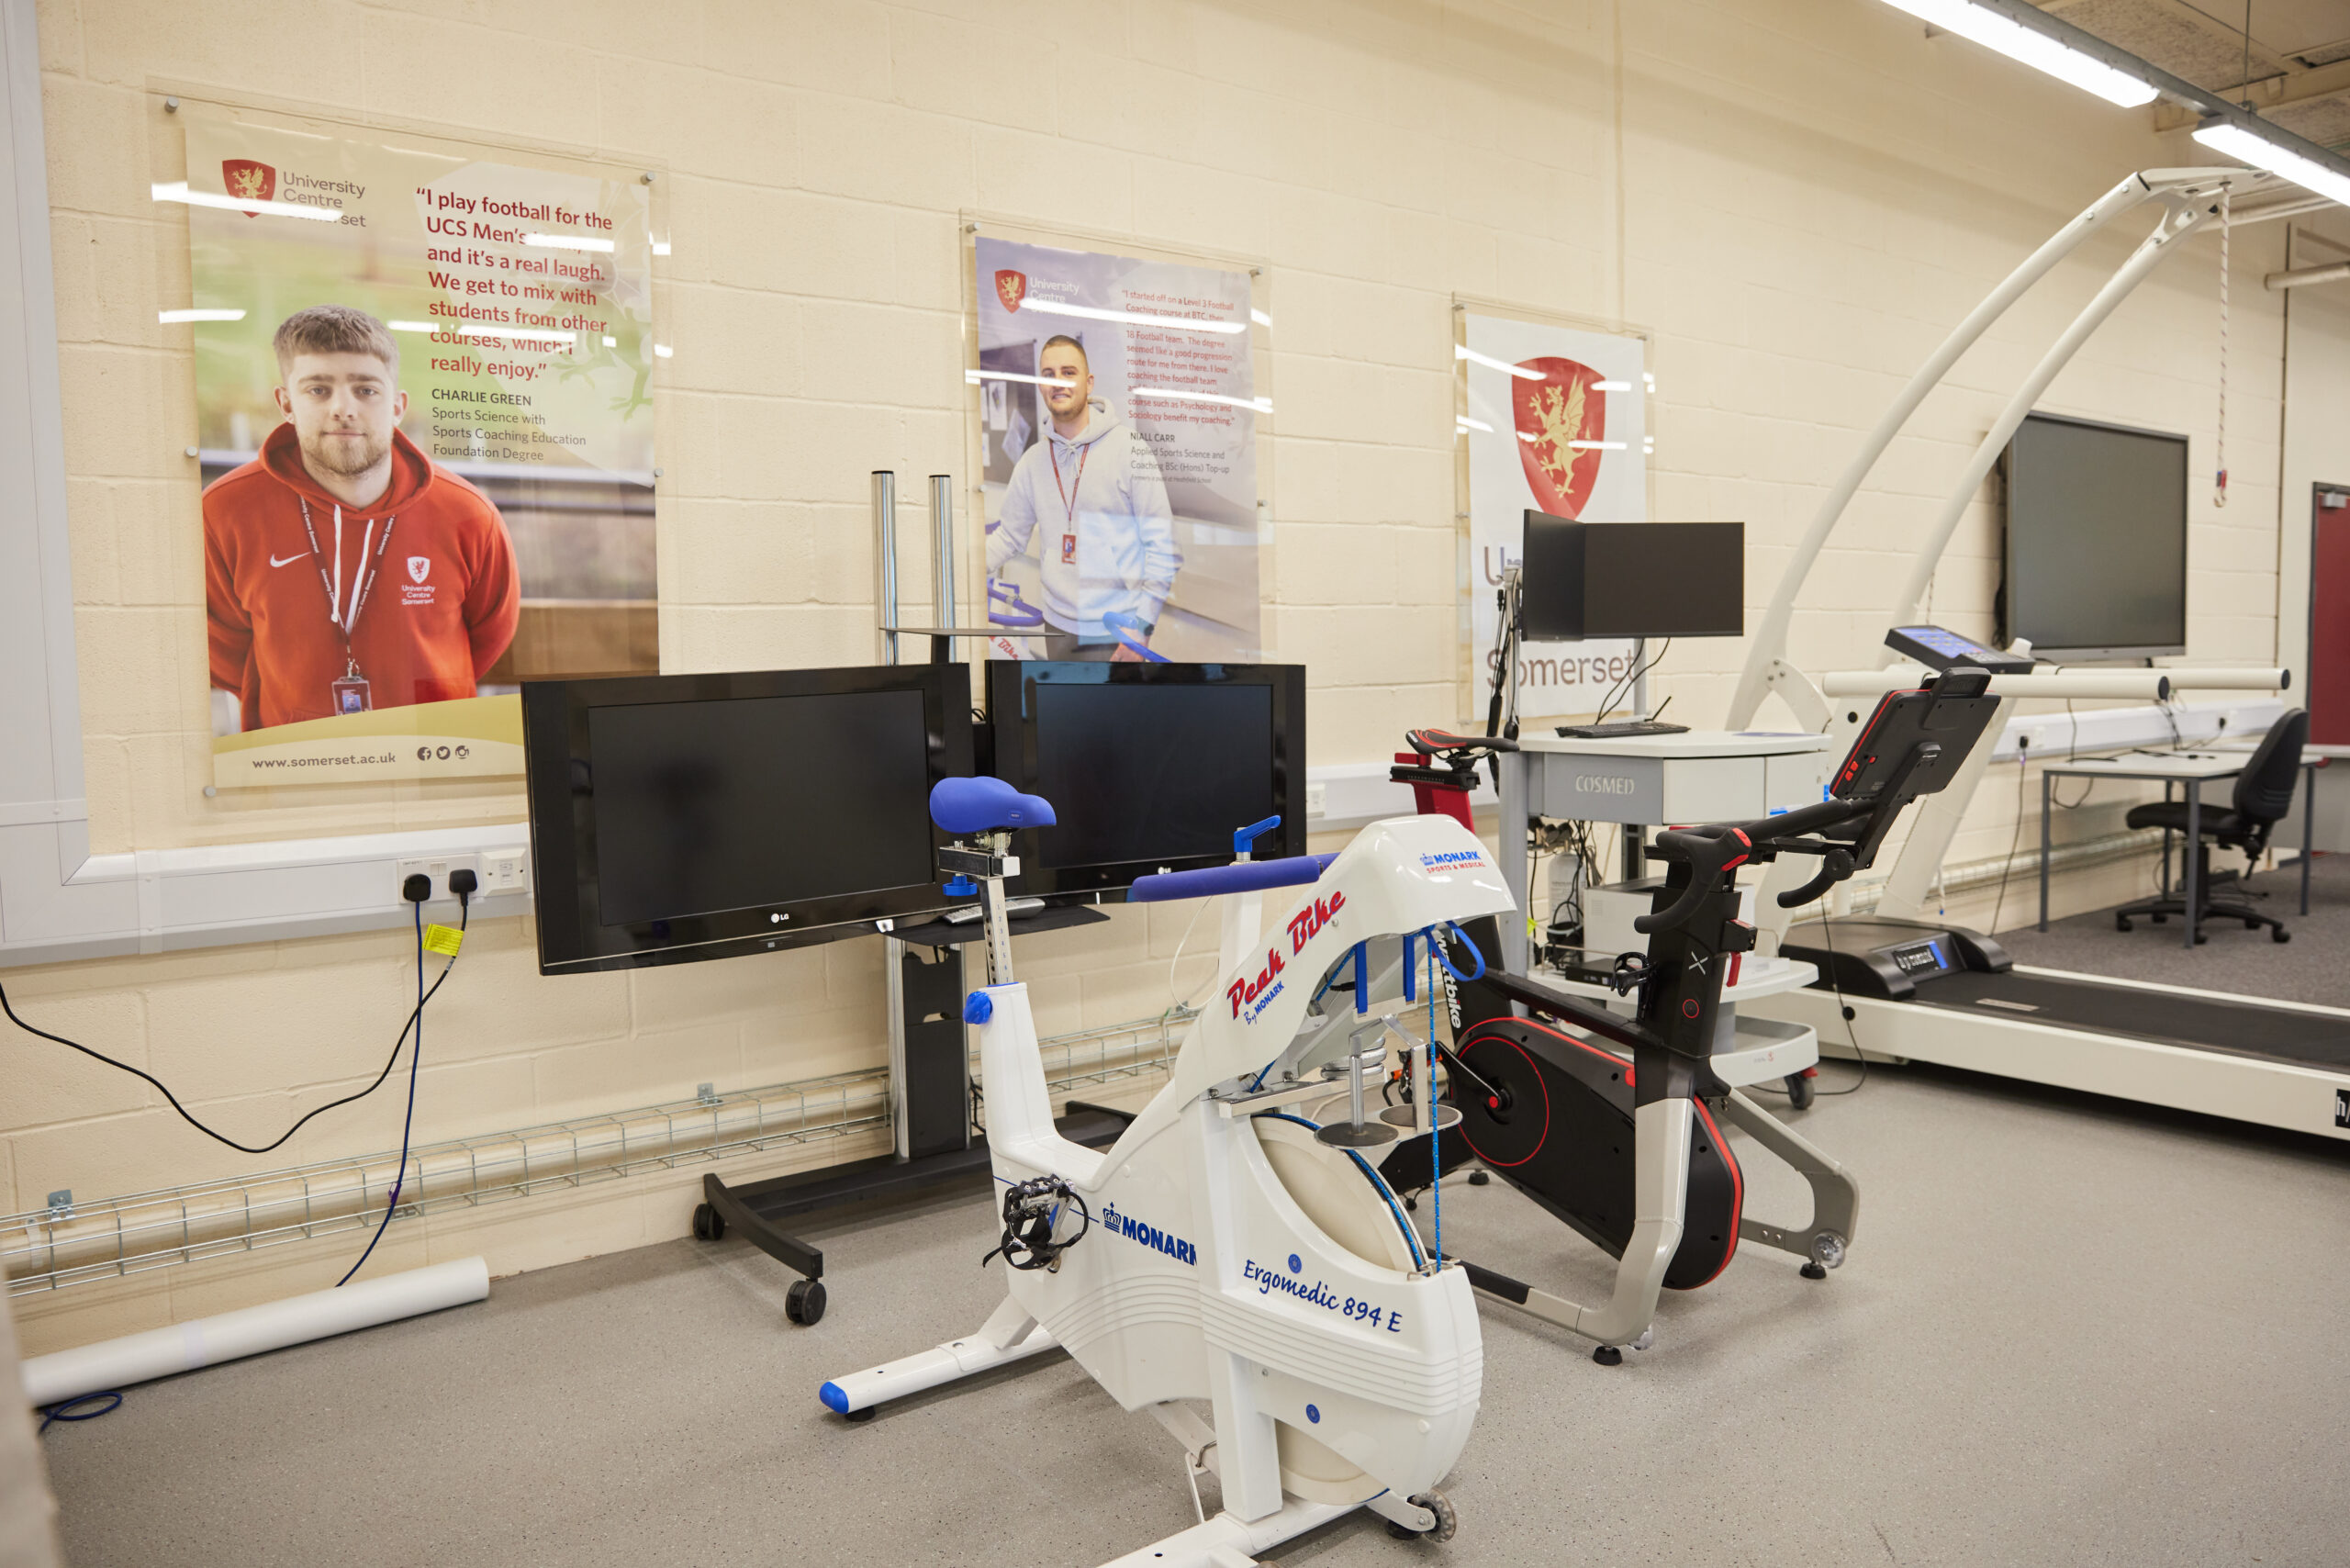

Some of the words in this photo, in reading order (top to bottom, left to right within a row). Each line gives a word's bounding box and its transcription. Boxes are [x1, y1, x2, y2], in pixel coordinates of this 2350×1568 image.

[283, 171, 365, 198] University
[284, 188, 342, 207] Centre
[439, 192, 476, 214] play
[482, 196, 550, 221] football
[555, 207, 580, 225] for
[585, 212, 612, 230] the
[427, 217, 467, 236] UCS
[474, 222, 527, 245] Men's
[427, 247, 462, 263] and
[467, 249, 494, 267] it's
[499, 257, 509, 269] a
[516, 258, 548, 274] real
[554, 259, 605, 283] laugh.
[429, 271, 460, 290] We
[466, 279, 495, 296] get
[500, 281, 519, 297] to
[524, 285, 554, 300] mix
[560, 288, 597, 306] with
[1030, 277, 1080, 296] University
[1030, 289, 1066, 303] Centre
[1130, 291, 1155, 302] started
[1183, 297, 1201, 307] Level
[1203, 299, 1206, 308] 3
[1208, 300, 1234, 310] Football
[429, 300, 509, 322] students
[514, 308, 556, 328] from
[562, 315, 607, 332] other
[1125, 303, 1158, 316] Coaching
[1158, 309, 1182, 318] course
[430, 331, 507, 352] courses,
[512, 338, 563, 355] which
[1126, 330, 1135, 339] 18
[1136, 330, 1163, 341] Football
[1165, 334, 1184, 343] team.
[1188, 336, 1200, 346] The
[1202, 337, 1225, 348] degree
[1126, 345, 1154, 354] seemed
[1156, 346, 1167, 355] like
[1175, 350, 1192, 359] good
[1193, 352, 1232, 362] progression
[431, 355, 481, 376] really
[487, 361, 546, 381] enjoy."
[1127, 358, 1146, 367] route
[1147, 359, 1158, 367] for
[1171, 361, 1188, 370] from
[1189, 362, 1209, 372] there.
[1214, 364, 1228, 375] love
[1127, 371, 1158, 383] coaching
[1159, 373, 1170, 382] the
[1172, 374, 1198, 384] football
[1200, 376, 1217, 386] team
[431, 388, 487, 403] CHARLIE
[490, 393, 532, 407] GREEN
[1153, 398, 1169, 408] such
[1181, 400, 1217, 412] Psychology
[1220, 404, 1232, 412] and
[432, 407, 471, 420] Sports
[475, 409, 519, 423] Science
[522, 414, 545, 425] with
[1128, 410, 1161, 421] Sociology
[1164, 411, 1188, 422] benefit
[433, 426, 471, 439] Sports
[476, 428, 529, 444] Coaching
[532, 432, 586, 445] Education
[1130, 432, 1152, 442] NIALL
[1155, 433, 1175, 442] CARR
[433, 444, 499, 458] Foundation
[503, 448, 543, 461] Degree
[1131, 446, 1158, 456] Applied
[1159, 448, 1182, 458] Sports
[1184, 450, 1210, 458] Science
[1212, 451, 1225, 459] and
[1131, 460, 1163, 471] Coaching
[1166, 462, 1178, 471] BSc
[1180, 462, 1203, 472] (Hons)
[1206, 464, 1230, 474] Top-up
[401, 584, 435, 593] University
[252, 752, 396, 768] www.somerset.ac.uk
[1575, 775, 1635, 795] COSMED
[1434, 850, 1481, 864] MONARK
[1427, 865, 1451, 874] SPORTS
[1226, 947, 1285, 1020] Peak
[1286, 890, 1346, 957] Bike
[1437, 935, 1461, 1028] wtbike
[1244, 1011, 1258, 1025] By
[1254, 980, 1284, 1014] MONARK
[1243, 1260, 1339, 1310] Ergomedic
[1342, 1296, 1382, 1327] 894
[1387, 1312, 1403, 1333] E
